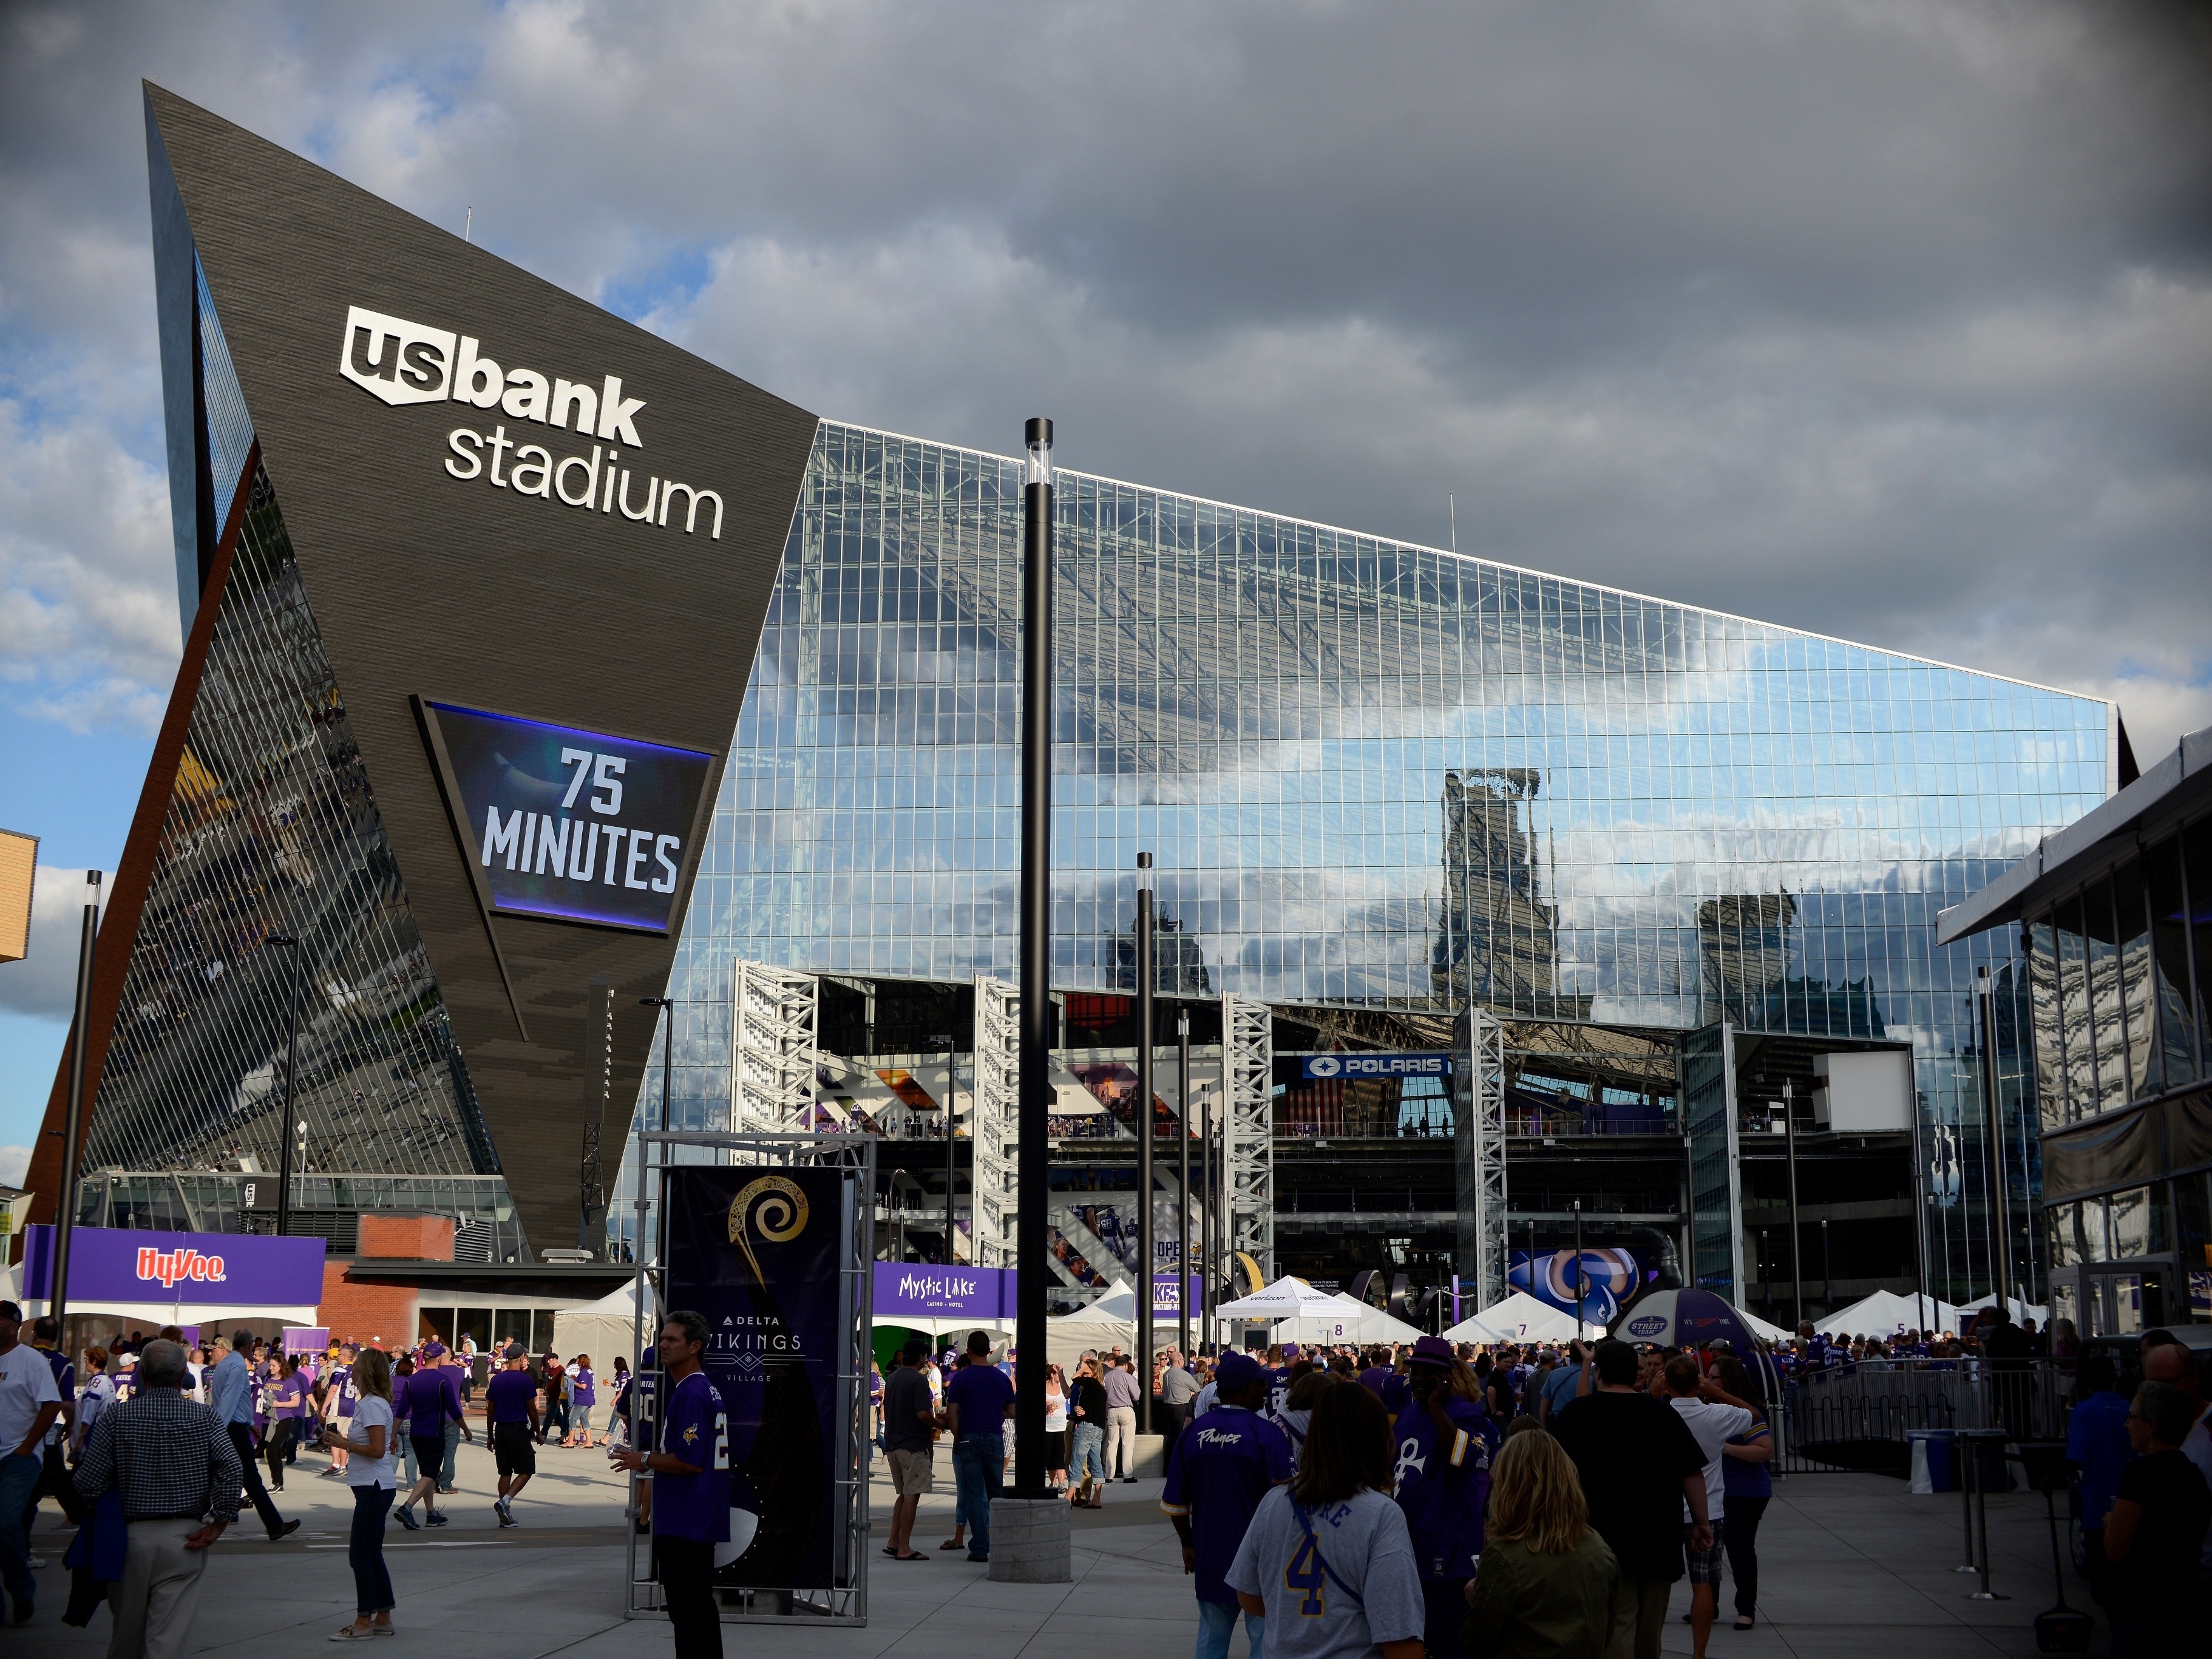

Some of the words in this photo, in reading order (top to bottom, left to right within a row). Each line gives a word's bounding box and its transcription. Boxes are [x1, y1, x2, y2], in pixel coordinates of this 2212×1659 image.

[444, 426, 724, 540] stadium
[561, 747, 626, 815] 75
[481, 806, 680, 894] MINUTES
[1346, 1059, 1442, 1073] POLARIS
[1158, 1241, 1180, 1257] OPE
[737, 1316, 779, 1326] DELTA
[1335, 1324, 1343, 1336] 8
[1519, 1324, 1527, 1335] 7
[1898, 1323, 1905, 1335] 5
[115, 1383, 129, 1403] 4
[1196, 1428, 1243, 1450] Prince
[1283, 1532, 1326, 1618] 4
